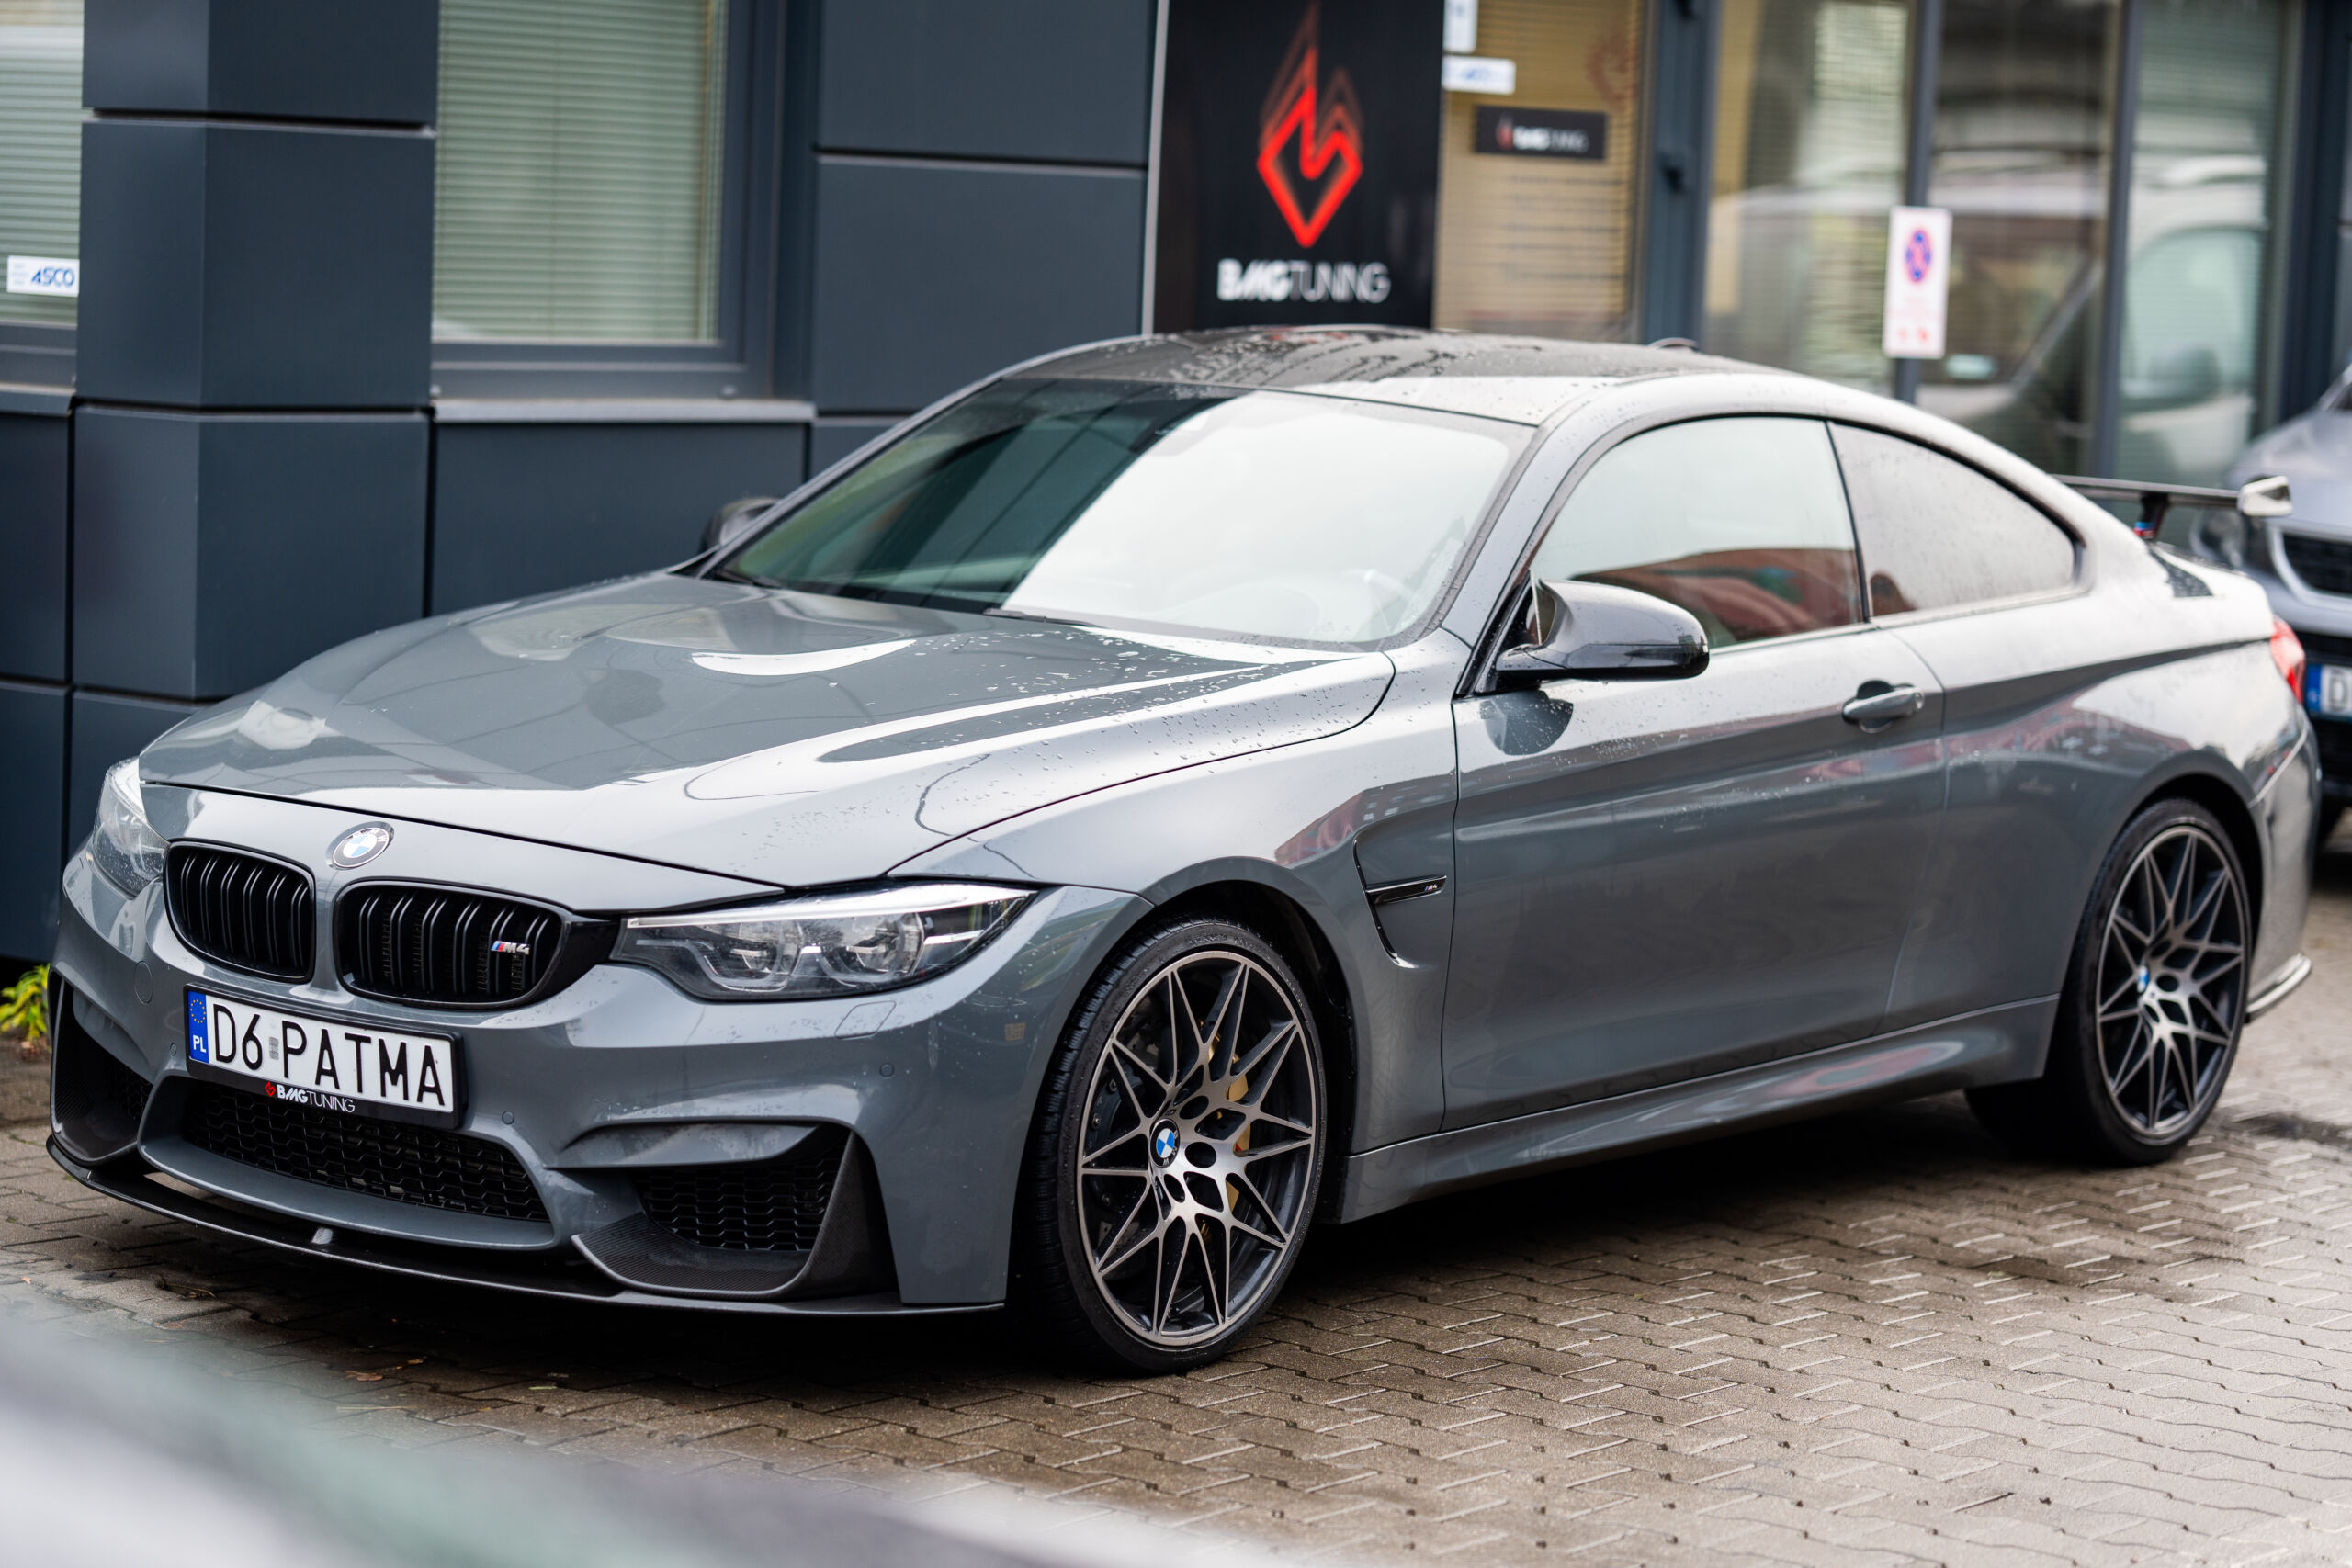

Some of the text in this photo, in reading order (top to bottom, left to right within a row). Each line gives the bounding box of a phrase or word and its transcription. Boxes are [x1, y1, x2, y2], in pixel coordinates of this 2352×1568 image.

[30, 266, 75, 287] ASCO
[503, 942, 530, 955] M4
[192, 1034, 207, 1054] PL
[213, 1003, 446, 1107] D6 PATMA
